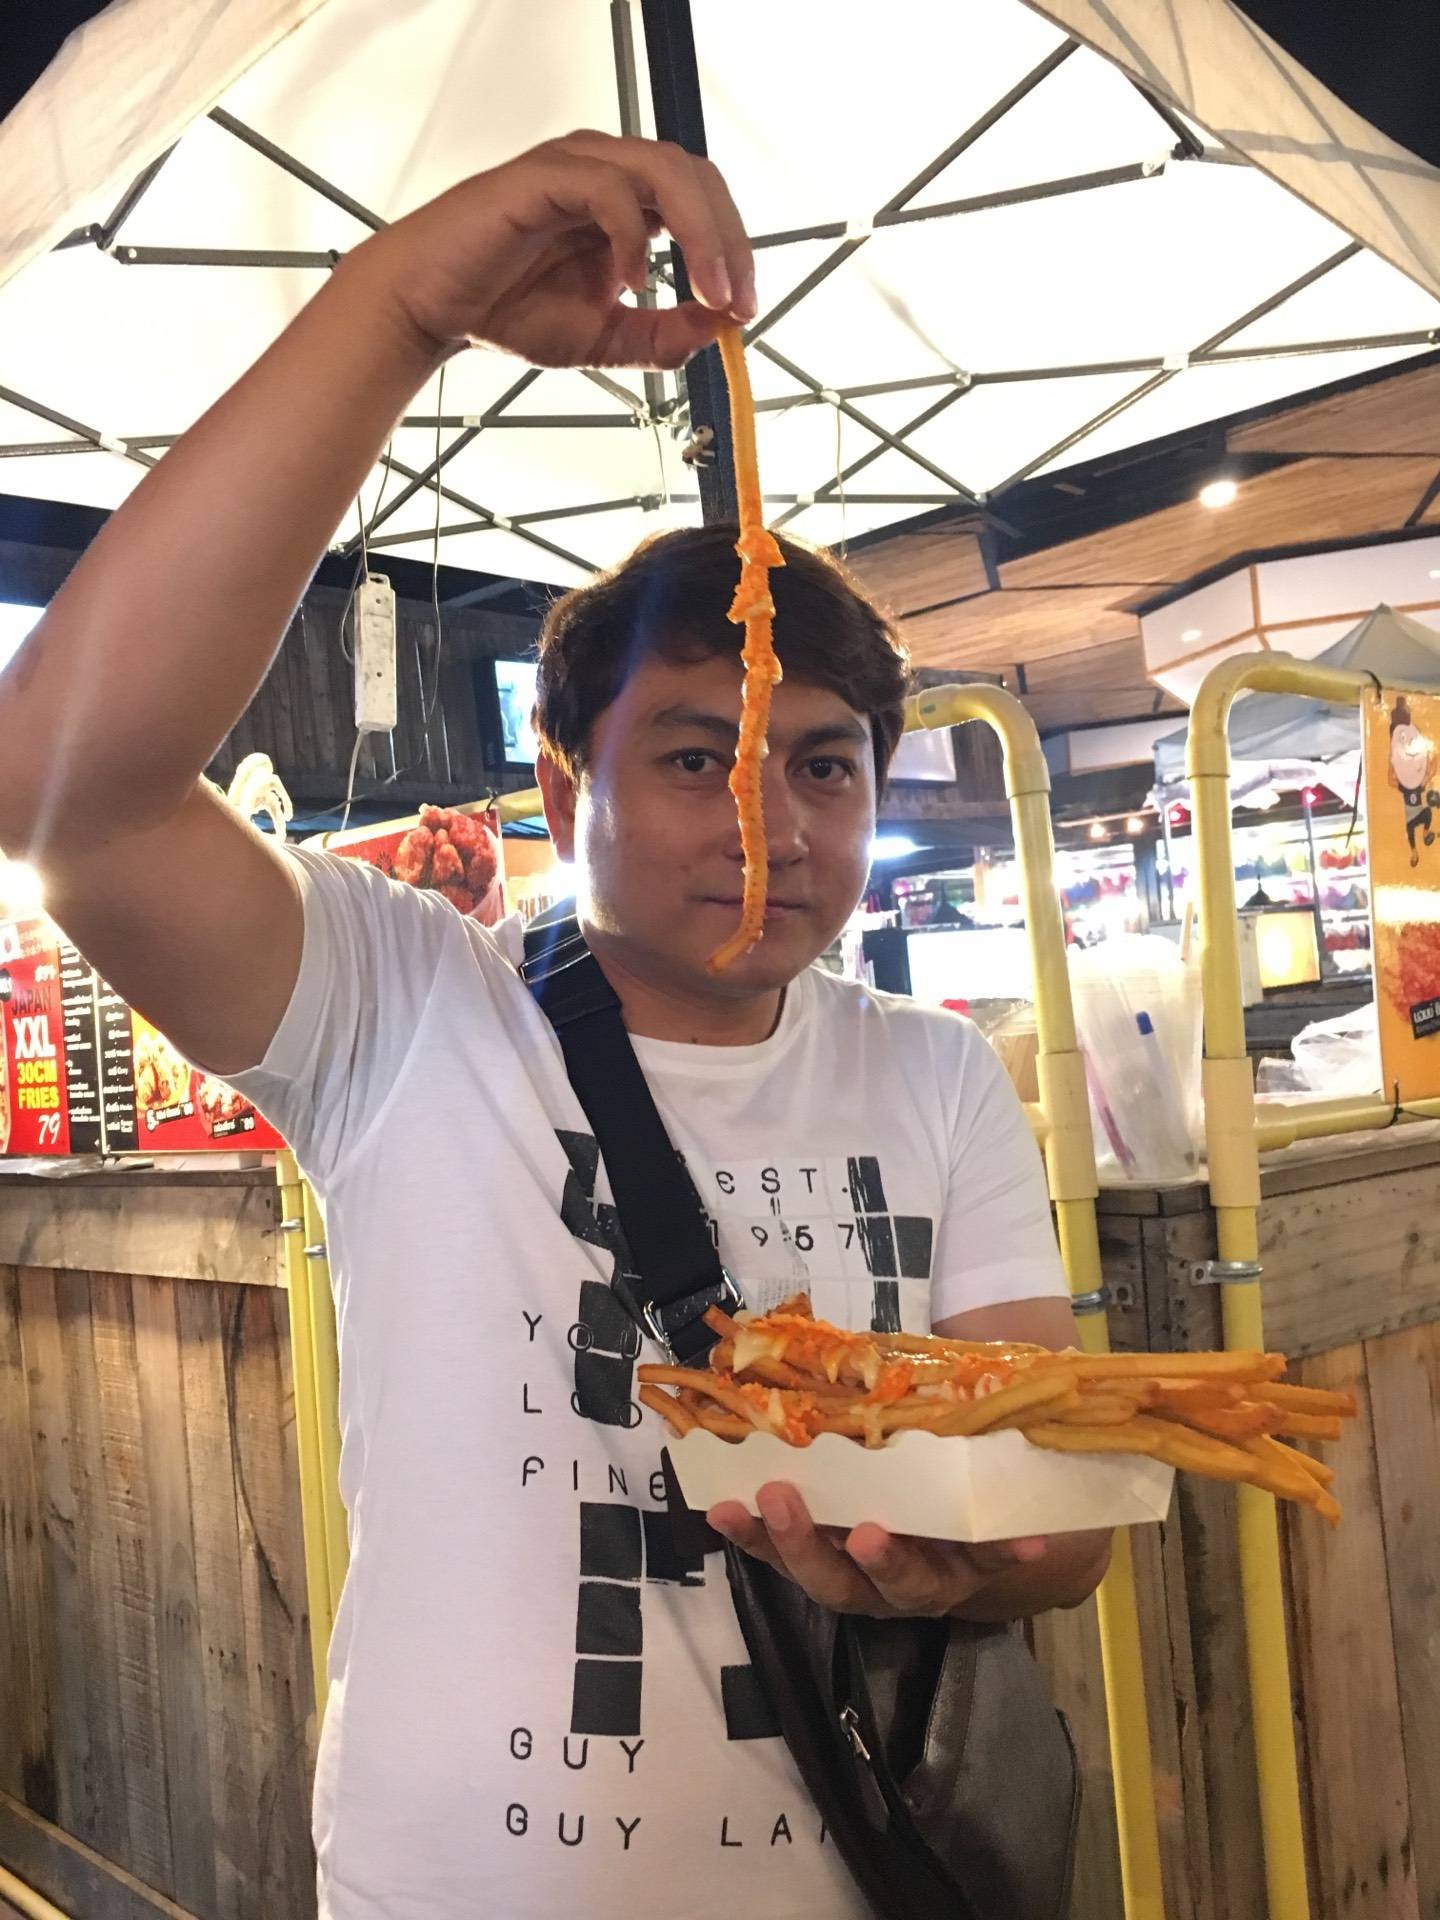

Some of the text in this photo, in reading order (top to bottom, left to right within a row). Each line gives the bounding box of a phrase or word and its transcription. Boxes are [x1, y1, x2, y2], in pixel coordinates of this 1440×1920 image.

[13, 1014, 56, 1059] XXL
[17, 1059, 57, 1084] 30CM
[18, 1086, 60, 1110] FRIES
[38, 1111, 61, 1145] 79
[715, 1167, 851, 1195] EST.
[709, 1219, 854, 1251] 1957
[522, 1310, 642, 1361] YOU
[523, 1383, 643, 1429] LOO
[522, 1455, 668, 1502] FINE
[510, 1727, 644, 1773] GUY
[506, 1803, 642, 1851] GUY
